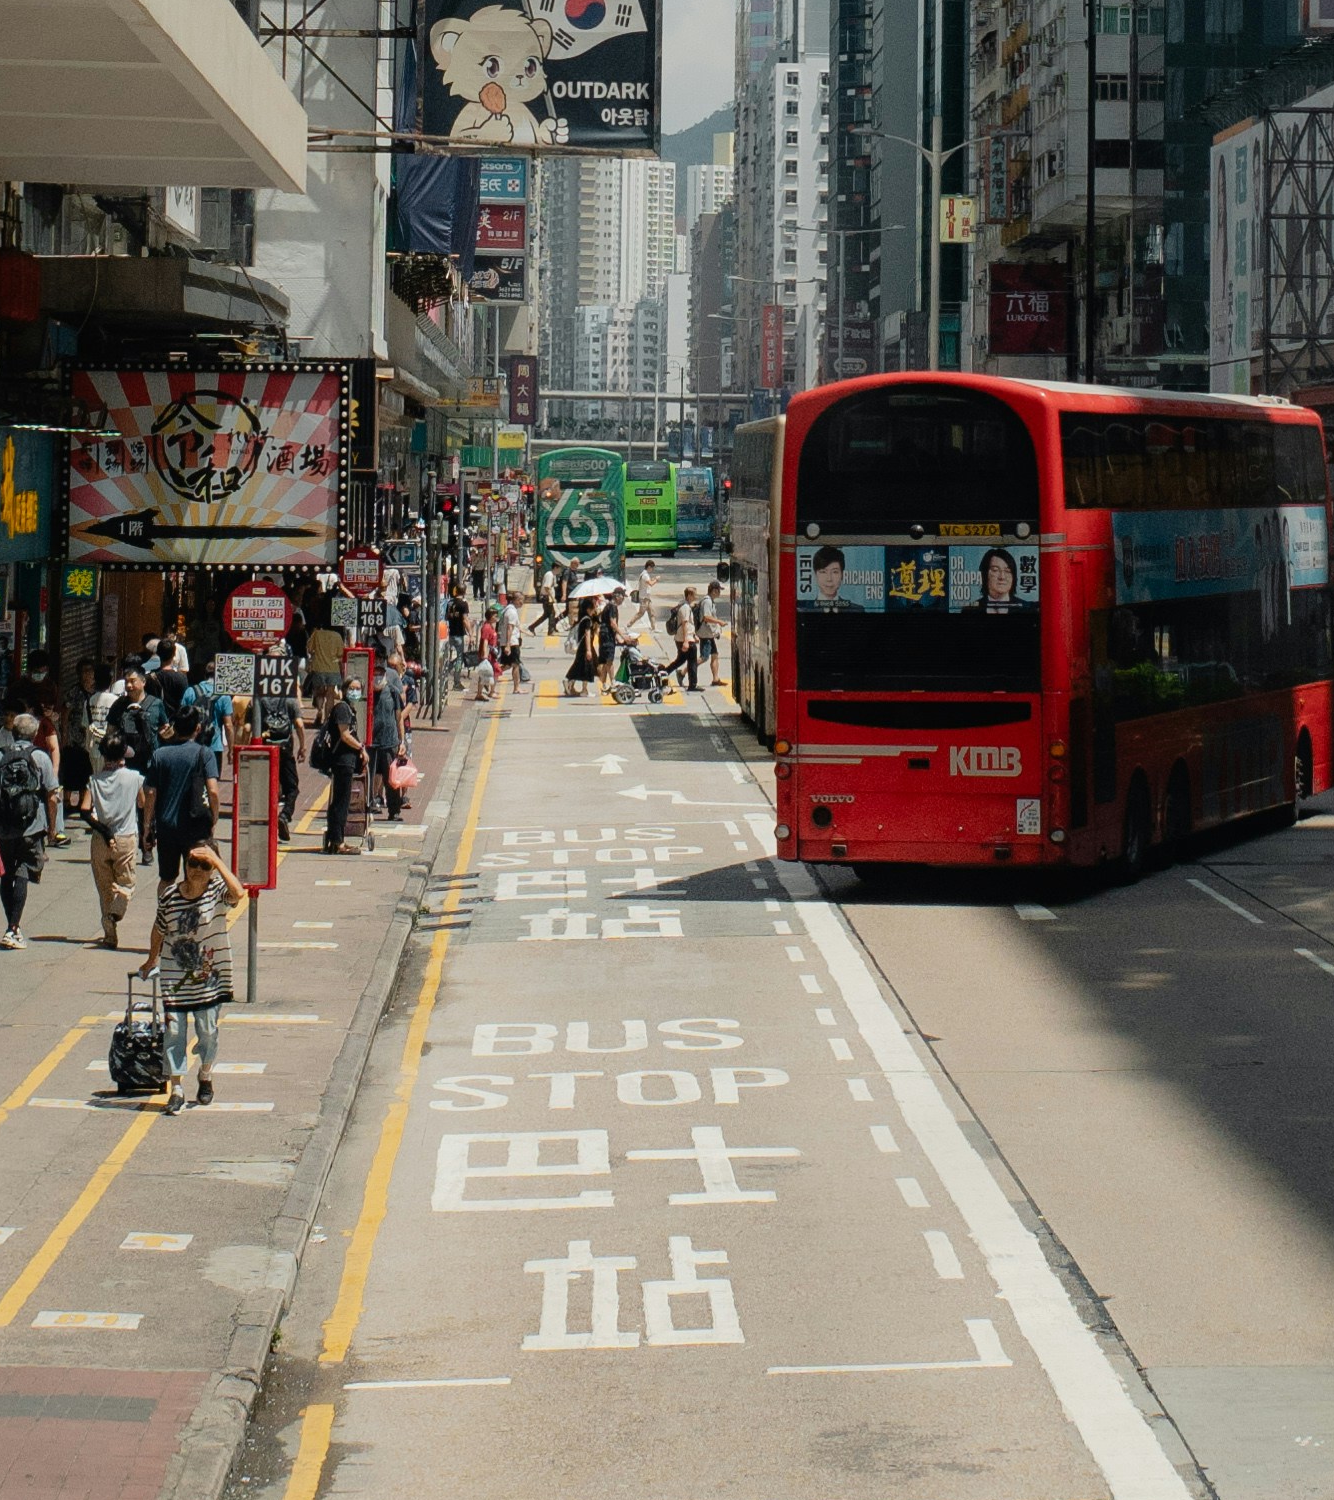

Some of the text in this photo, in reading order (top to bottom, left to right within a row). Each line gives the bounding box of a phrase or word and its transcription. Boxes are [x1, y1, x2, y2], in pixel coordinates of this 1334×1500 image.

[553, 81, 649, 100] OUTDARK
[601, 108, 649, 126] 아웃닭
[503, 211, 520, 221] 2/F
[501, 258, 523, 269] 5/F
[1006, 291, 1049, 313] 六福
[1006, 314, 1049, 322] LUKFOOK
[517, 364, 530, 417] 周大福
[266, 444, 330, 476] 酒場
[400, 548, 413, 562] P
[951, 556, 964, 569] DR
[799, 554, 812, 594] IELTS
[844, 570, 883, 585] RICHARD
[889, 562, 946, 601] 遵理
[951, 571, 982, 585] KOOPA
[1019, 555, 1038, 594] 數學
[865, 586, 883, 600] ENG
[951, 587, 971, 600] KOO
[361, 601, 383, 613] MK
[360, 614, 384, 626] 168
[260, 659, 293, 676] MK
[259, 679, 294, 695] 167
[949, 746, 1022, 777] KMB
[811, 795, 854, 803] VOLVO
[501, 826, 676, 847] BUS
[475, 847, 704, 868] STOP
[494, 869, 687, 901] 巴士
[517, 905, 683, 941] 站
[471, 1018, 745, 1056] BUS
[428, 1068, 789, 1111] STOP
[431, 1126, 803, 1212] 巴士
[522, 1236, 745, 1351] 站
